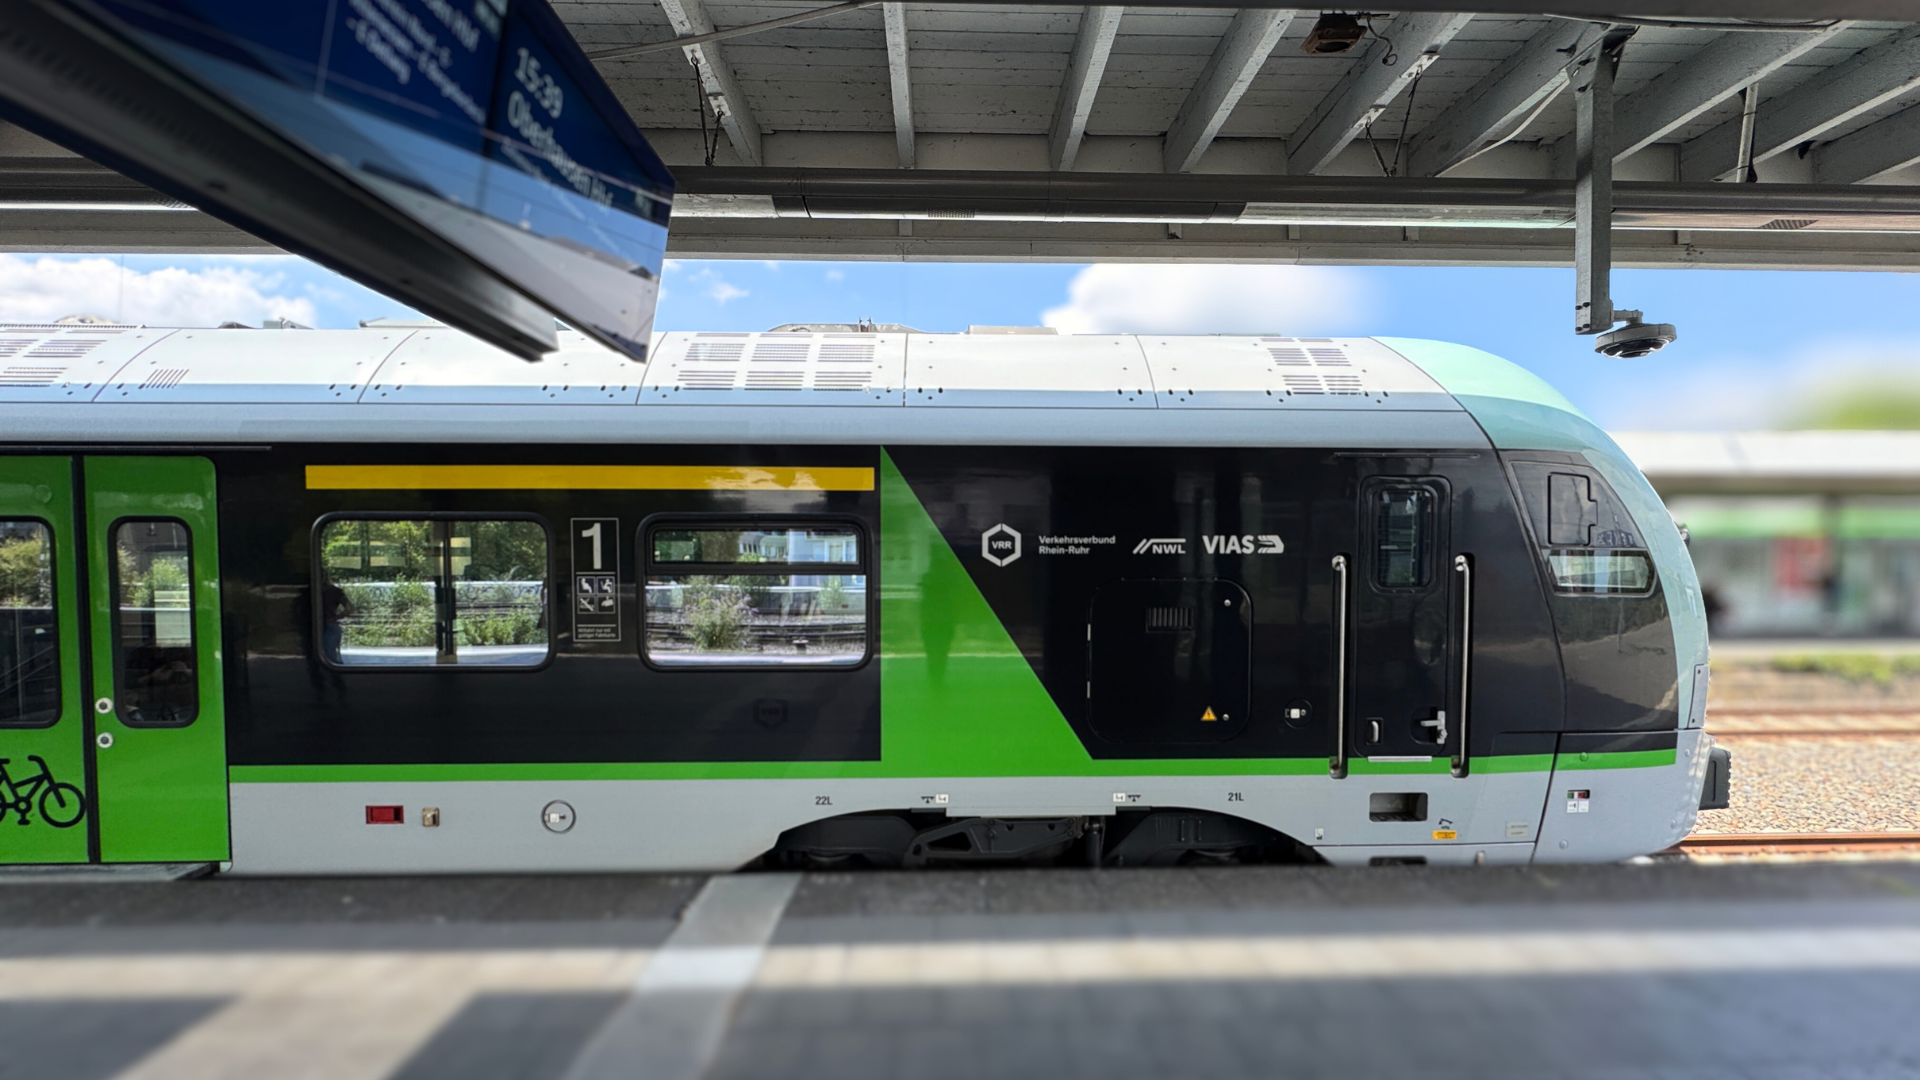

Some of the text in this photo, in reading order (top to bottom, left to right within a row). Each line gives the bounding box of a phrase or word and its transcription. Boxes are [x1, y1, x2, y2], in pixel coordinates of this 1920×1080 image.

[514, 47, 564, 119] 15:39
[508, 90, 591, 198] Oberhausen
[991, 540, 1012, 550] VRR
[1038, 535, 1116, 545] Verkehrsverbund
[1202, 535, 1255, 554] VIAS
[582, 523, 602, 570] 1
[1038, 545, 1090, 555] Rhein-Ruhr
[1152, 544, 1186, 554] NWL
[815, 795, 833, 806] 22L
[1227, 792, 1245, 802] 21L
